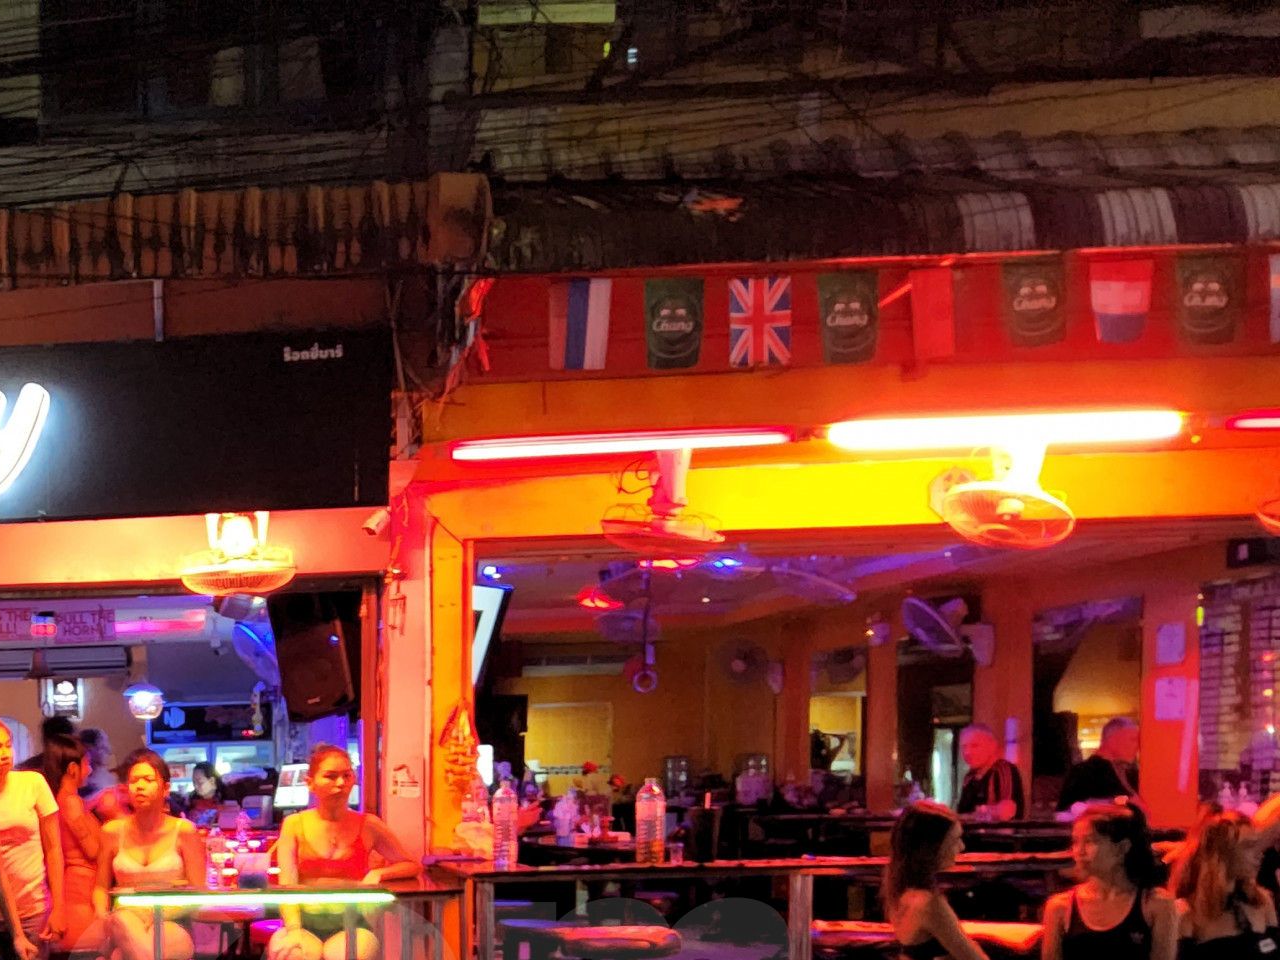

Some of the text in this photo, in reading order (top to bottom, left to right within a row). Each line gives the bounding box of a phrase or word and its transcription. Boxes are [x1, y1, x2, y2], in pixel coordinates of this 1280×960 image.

[652, 319, 694, 334] Chang
[826, 312, 869, 328] Chang
[7, 608, 31, 621] THE
[56, 612, 87, 624] PULL
